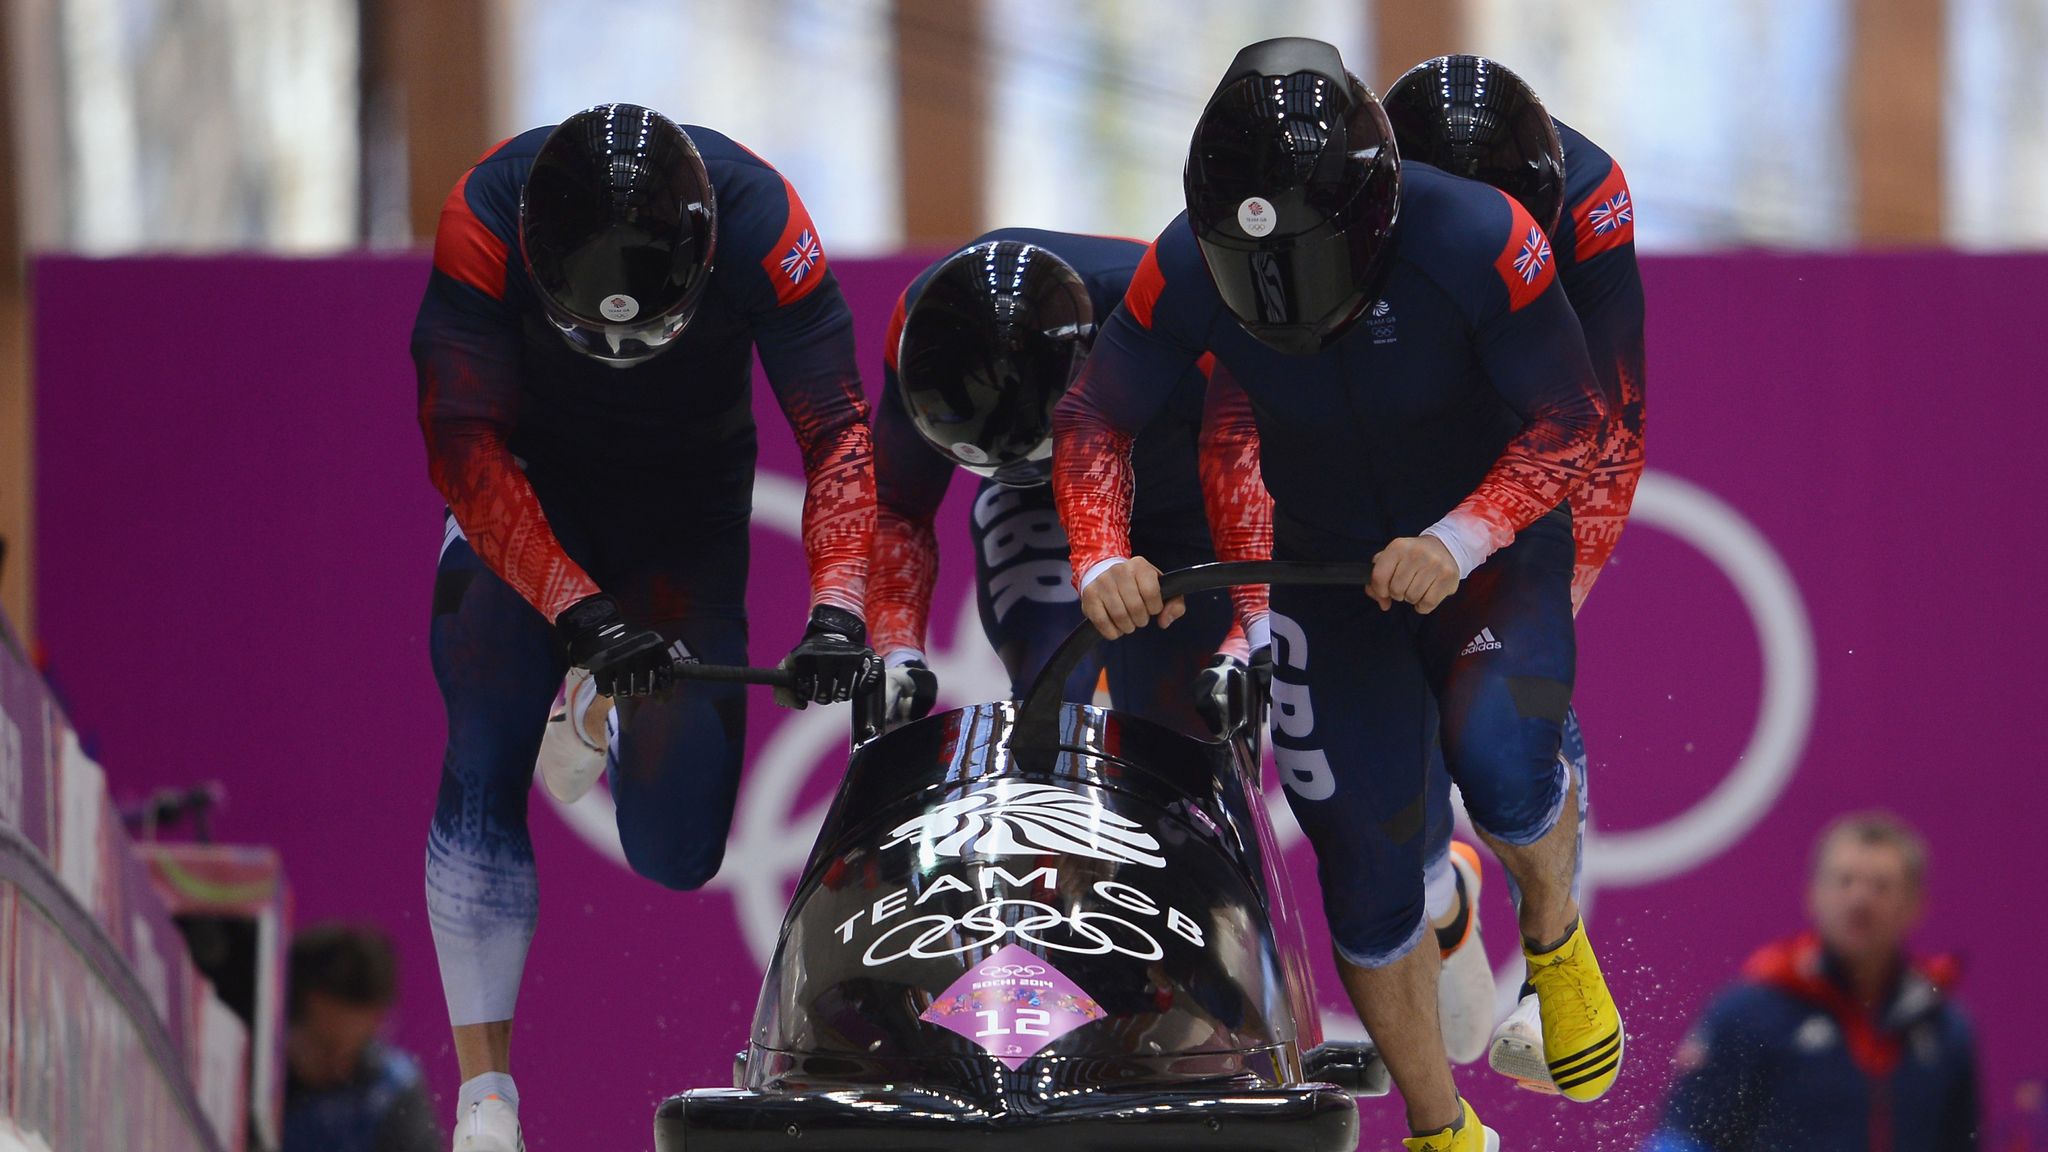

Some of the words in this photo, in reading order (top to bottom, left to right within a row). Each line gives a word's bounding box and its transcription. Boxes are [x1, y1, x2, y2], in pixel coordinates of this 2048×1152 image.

[1461, 641, 1502, 656] adidas
[834, 866, 1058, 944] TEAM
[1092, 880, 1205, 947] GB
[972, 978, 1016, 990] SOCHI
[1020, 978, 1054, 989] 2014
[975, 1008, 1050, 1037] 12
